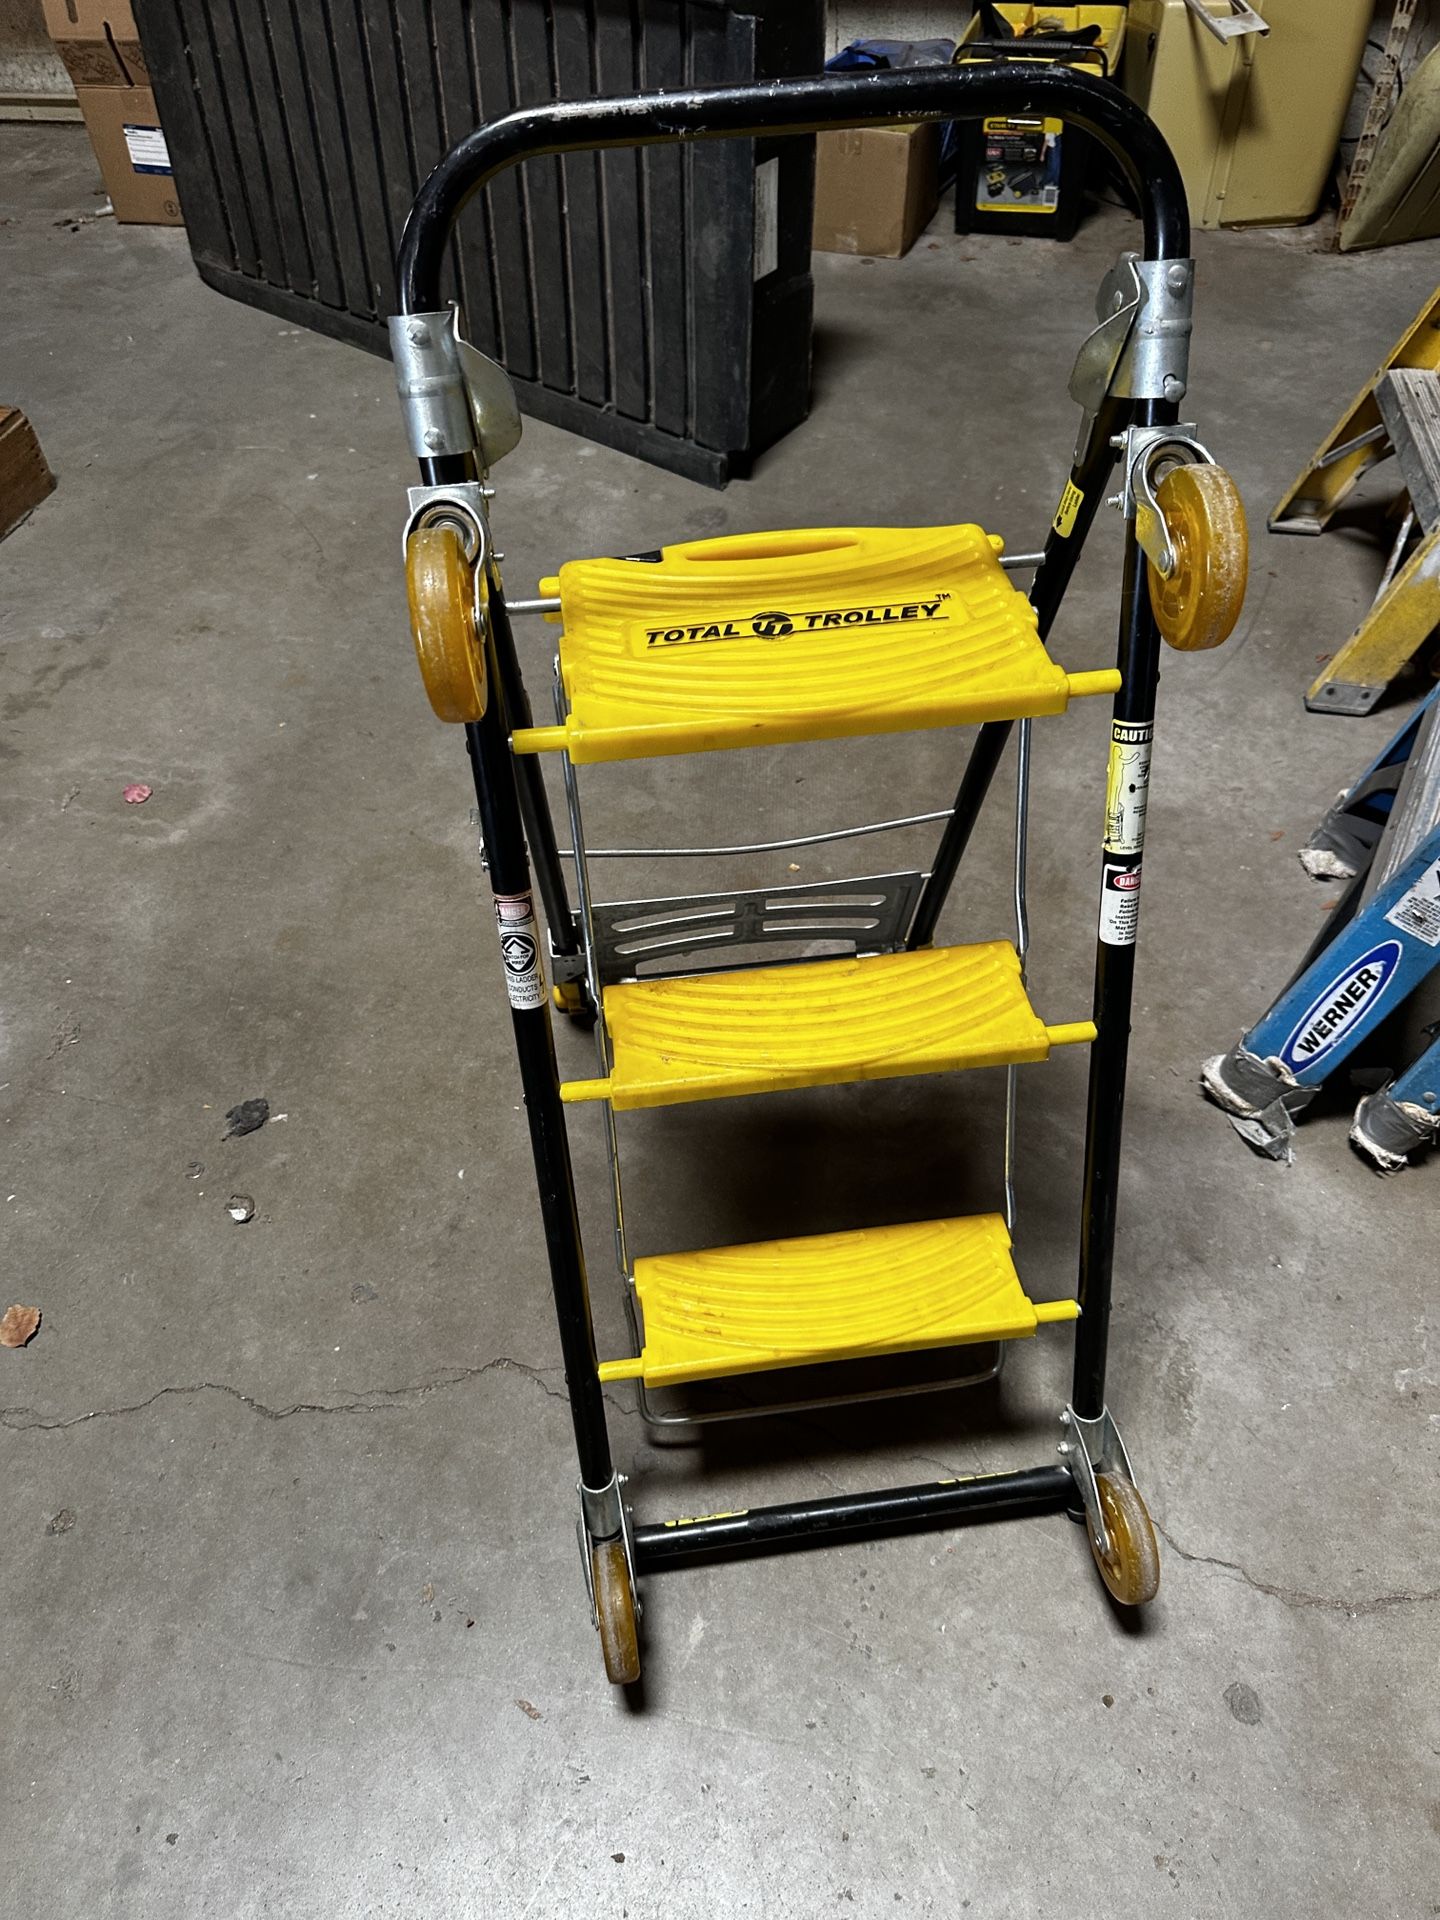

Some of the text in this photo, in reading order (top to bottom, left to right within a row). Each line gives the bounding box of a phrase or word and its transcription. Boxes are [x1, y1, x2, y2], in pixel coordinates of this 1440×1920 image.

[646, 624, 740, 645] TOTAL
[805, 603, 941, 628] TROLLEY
[936, 593, 951, 601] TM
[499, 905, 528, 918] ANGER
[516, 973, 538, 983] LADDER
[1297, 968, 1379, 1054] WERNER
